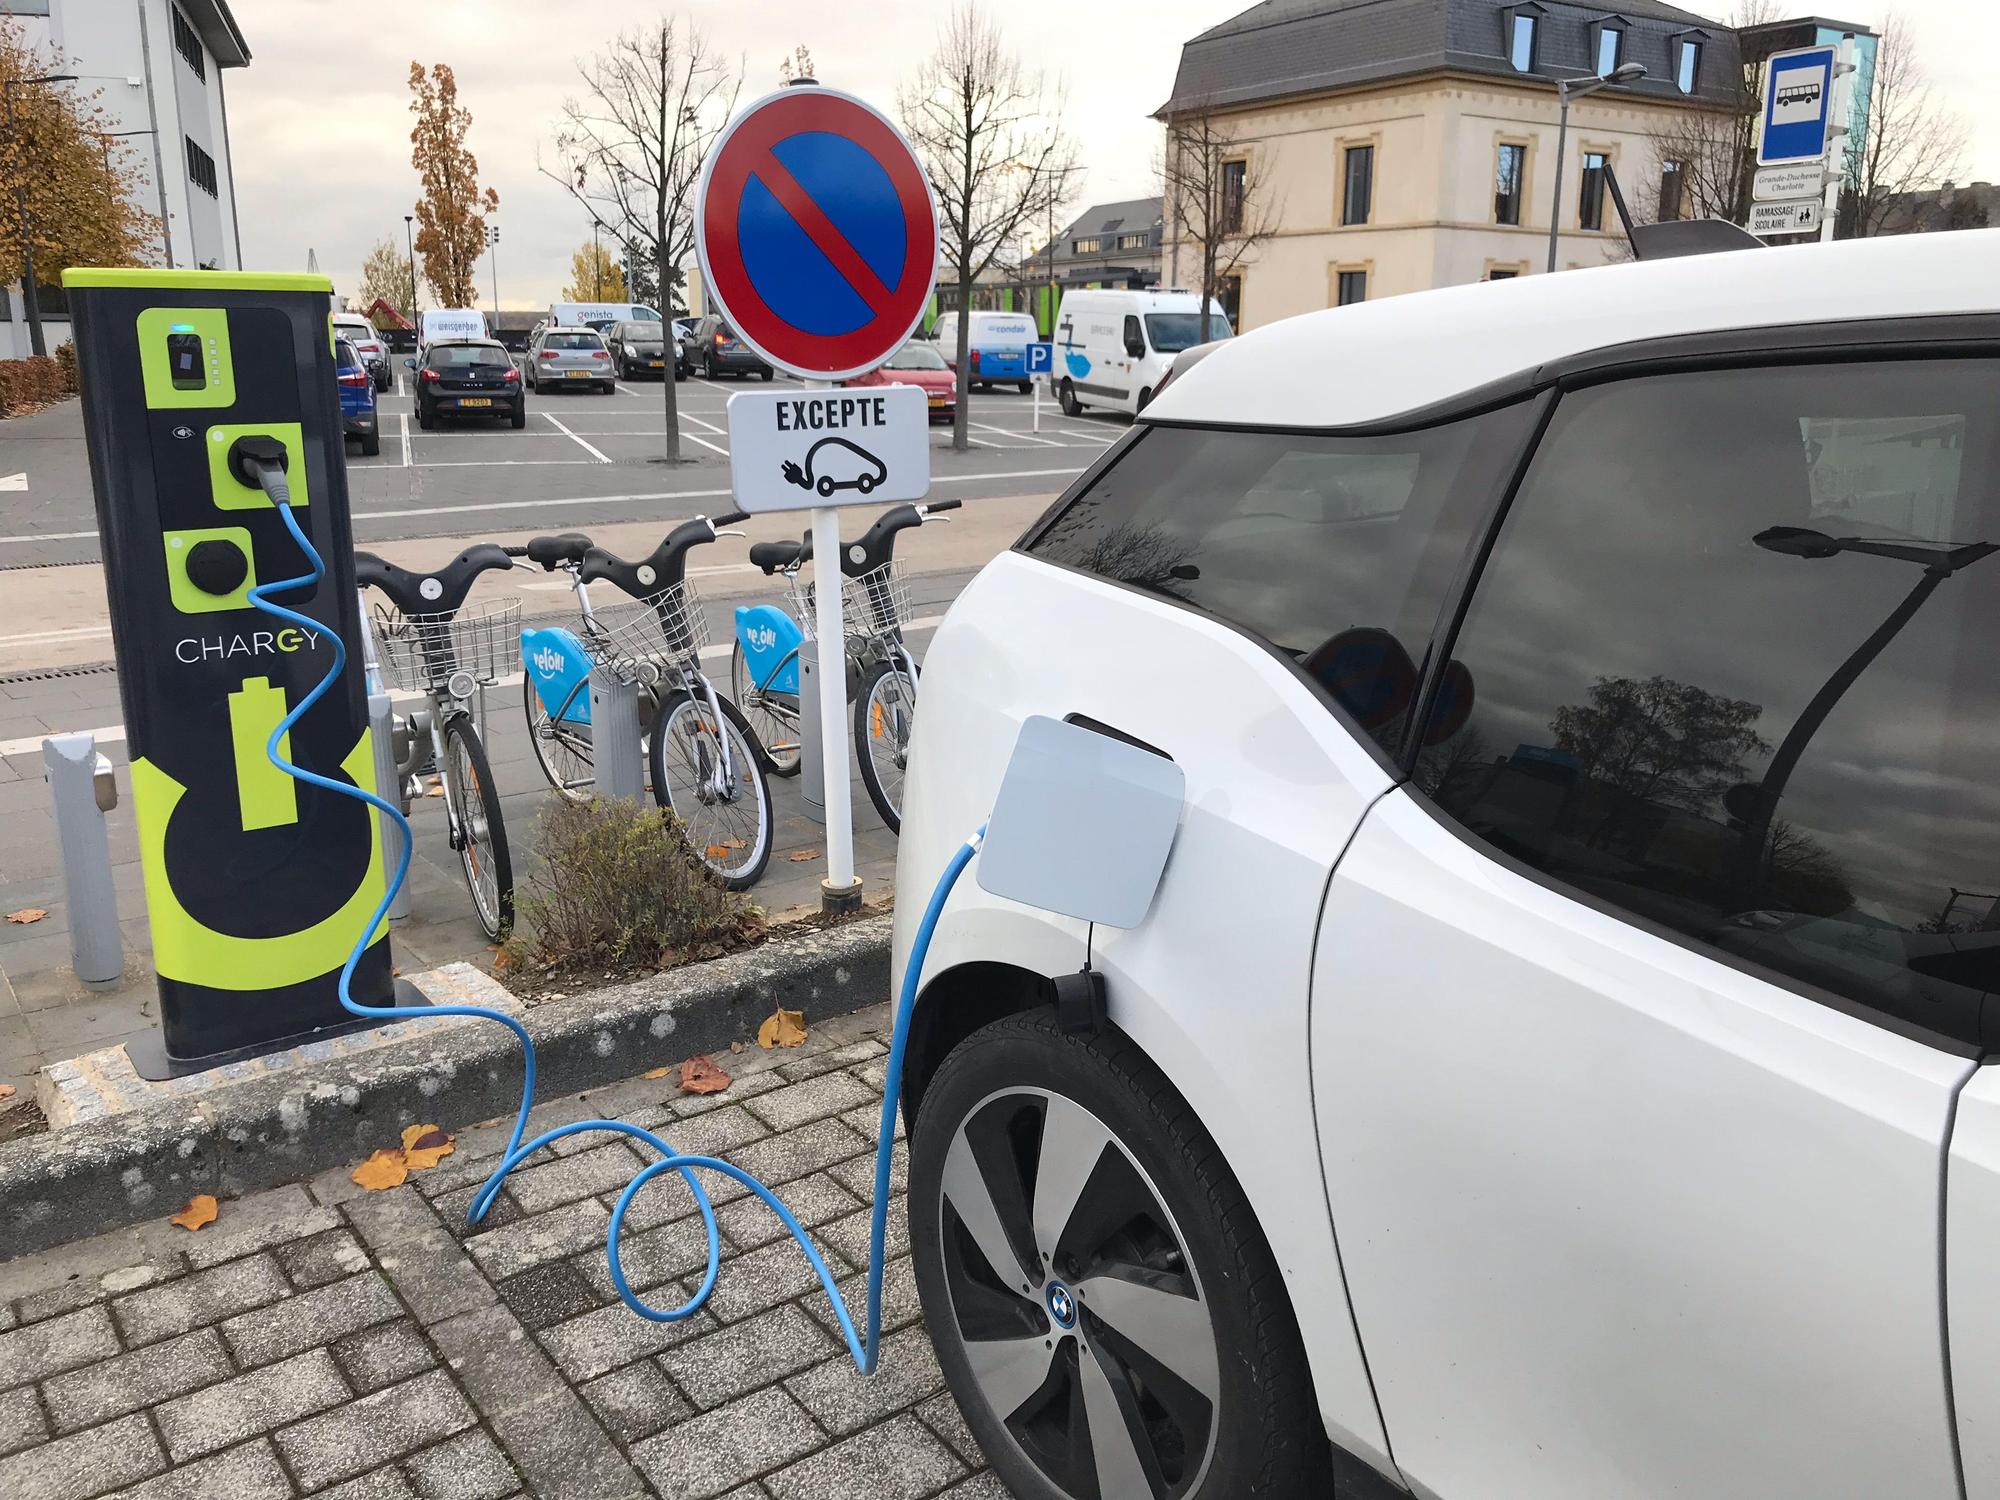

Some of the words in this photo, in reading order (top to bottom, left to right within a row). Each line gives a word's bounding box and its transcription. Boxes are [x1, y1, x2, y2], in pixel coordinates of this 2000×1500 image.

[1758, 173, 1821, 184] Grande-Duchesse
[1771, 183, 1805, 192] Charlotte
[1755, 206, 1795, 218] RAMASSAGE
[1754, 219, 1786, 230] SCOLAIRE
[577, 309, 613, 322] genista
[437, 321, 478, 332] weisgerber
[1031, 346, 1047, 370] P
[776, 398, 887, 431] EXCEPTE
[176, 627, 319, 664] CHARGY
